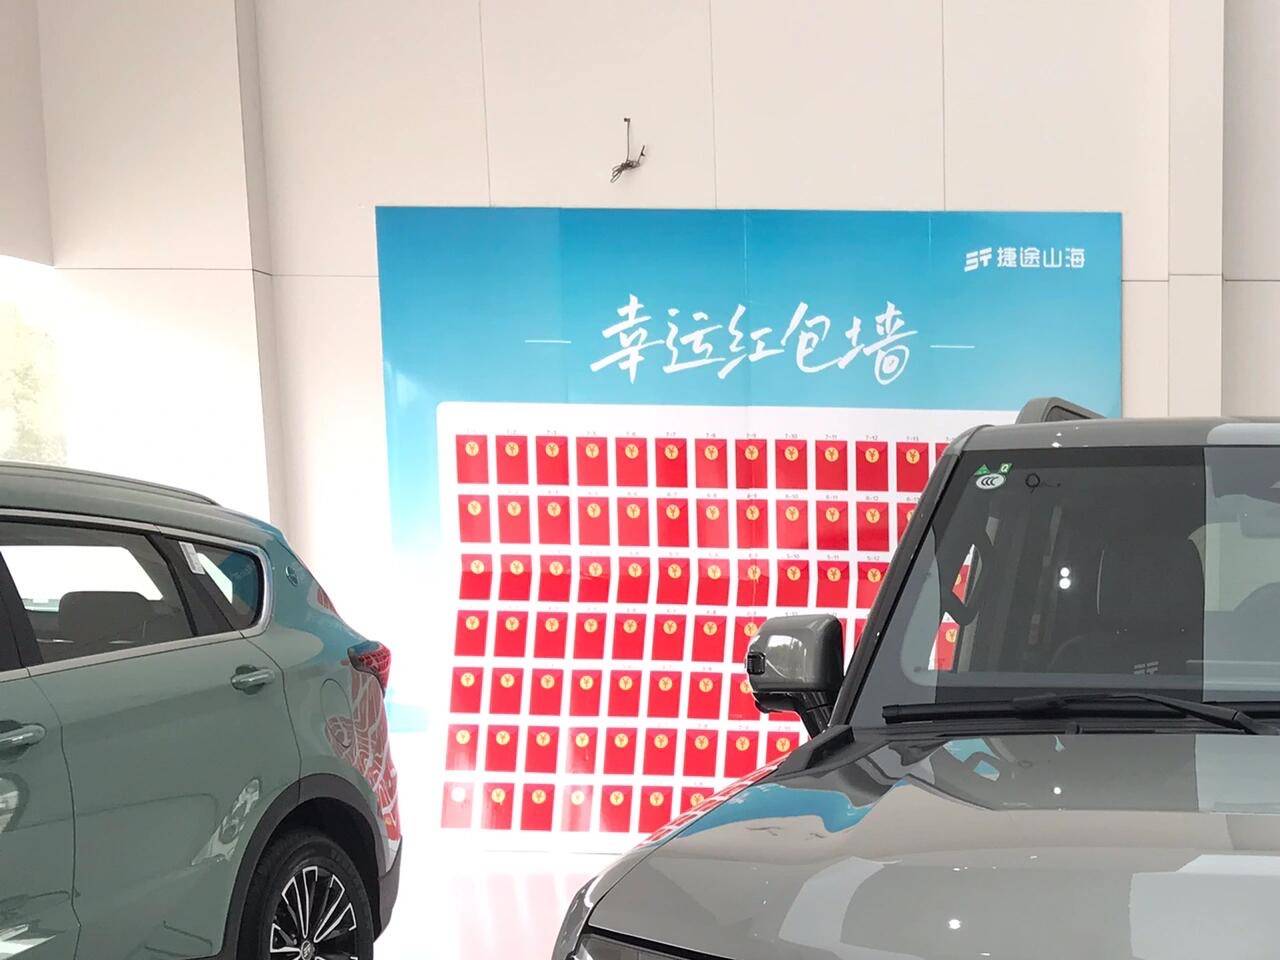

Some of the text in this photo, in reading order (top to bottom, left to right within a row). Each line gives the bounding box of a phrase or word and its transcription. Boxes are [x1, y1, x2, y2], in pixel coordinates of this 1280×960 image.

[997, 246, 1085, 268] 捷途山海
[590, 293, 918, 385] 幸运红包墙
